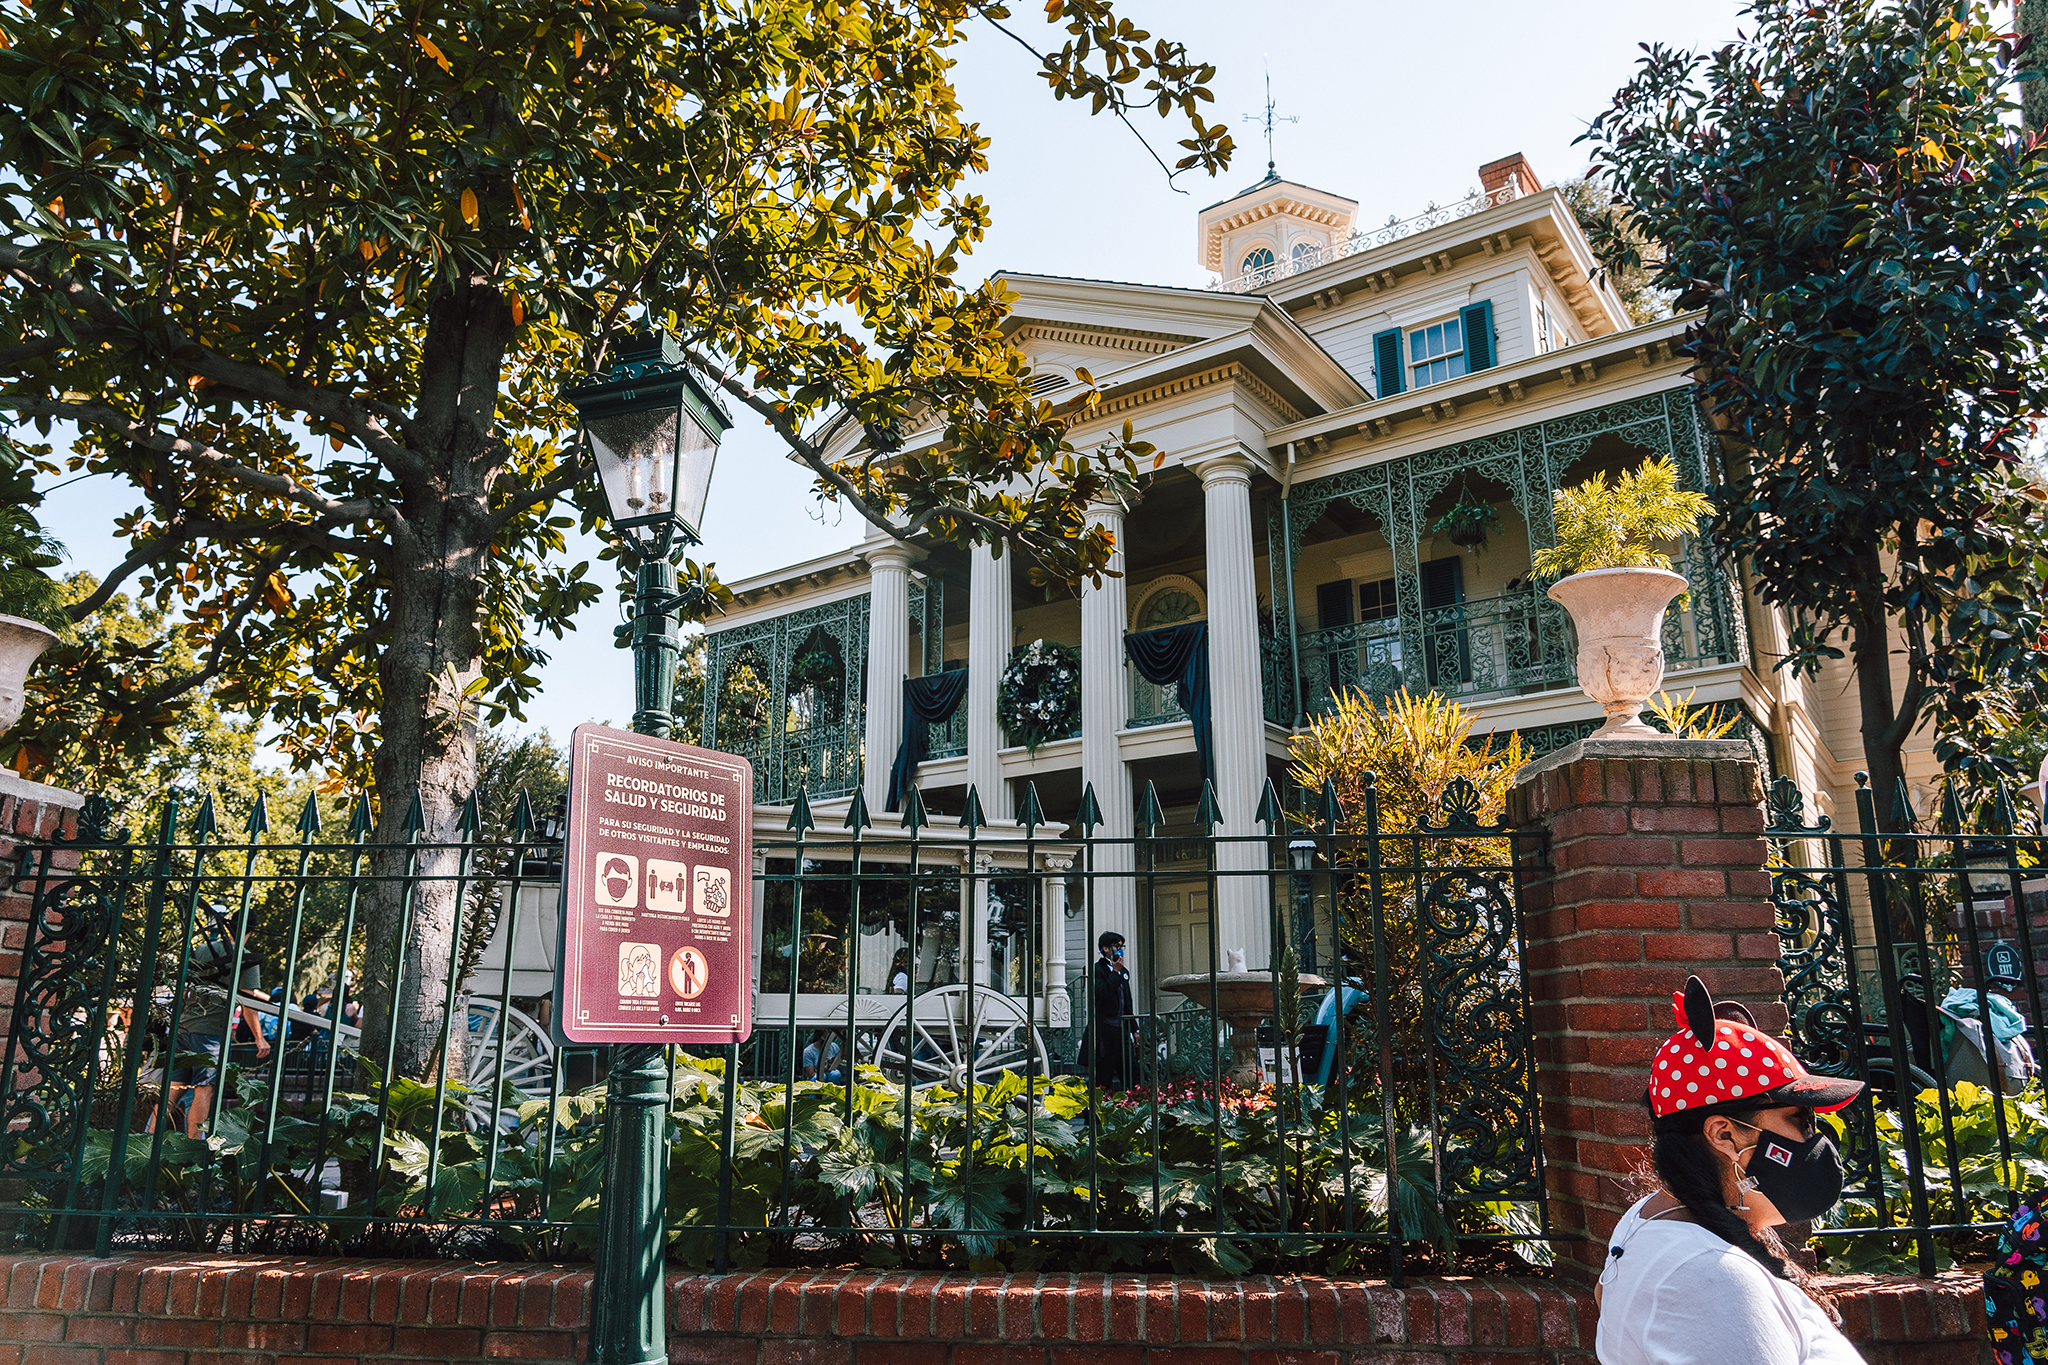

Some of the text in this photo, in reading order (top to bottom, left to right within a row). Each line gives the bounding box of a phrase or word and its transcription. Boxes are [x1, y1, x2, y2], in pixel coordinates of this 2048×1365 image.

[1290, 115, 1300, 123] W
[627, 755, 709, 779] AVISO IMPORTANTE
[607, 773, 725, 806] RECORDATORIOS DE
[604, 790, 726, 822] SALUD Y SEGURIDAD
[599, 817, 620, 828] PARA
[622, 820, 631, 829] SU
[633, 822, 674, 835] SEGURIDAD
[682, 830, 690, 838] LA
[692, 831, 730, 844] SEGURIDAD
[599, 828, 609, 837] DE
[611, 830, 637, 841] OTROS
[638, 834, 680, 848] VISITANTES
[687, 841, 730, 855] EMPLEADOS:
[1999, 964, 2012, 974] EXIT
